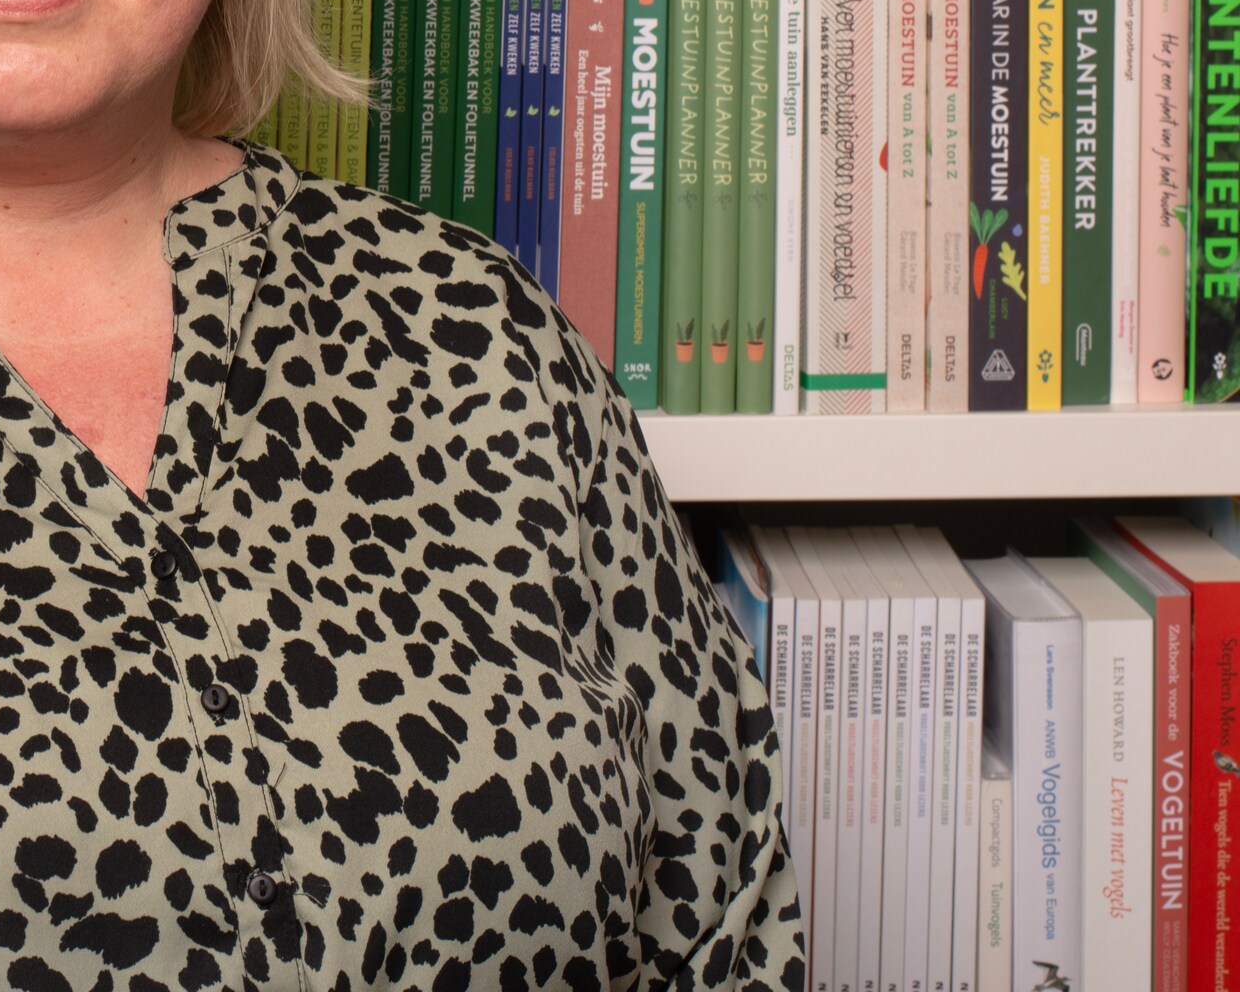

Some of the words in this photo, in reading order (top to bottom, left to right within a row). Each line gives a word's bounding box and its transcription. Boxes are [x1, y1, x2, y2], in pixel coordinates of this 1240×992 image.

[550, 13, 562, 33] ZELF
[787, 11, 801, 44] tuin
[991, 23, 1009, 46] IN
[1038, 22, 1057, 53] en
[483, 7, 495, 73] HANDBOEK
[549, 35, 561, 74] KWEKEN
[577, 50, 588, 70] Een
[991, 51, 1009, 80] DE
[466, 80, 479, 99] EN
[482, 78, 494, 114] VOOR
[577, 72, 588, 92] heel
[592, 66, 612, 108] Mijn
[783, 52, 801, 136] aanleggen
[1037, 60, 1060, 126] meer
[576, 95, 587, 116] jaar
[629, 18, 658, 190] MOESTUIN
[821, 83, 829, 135] EEKELEN
[902, 93, 912, 125] van
[1074, 9, 1098, 229] PLANTTREKKER
[574, 117, 586, 159] oogsten
[903, 129, 914, 140] A
[990, 86, 1010, 201] MOESTUIN
[462, 105, 478, 201] FOLIETUNNEL
[575, 162, 585, 177] uit
[590, 113, 609, 199] moestuin
[903, 143, 912, 165] tot
[575, 180, 585, 191] de
[903, 169, 914, 178] Z
[574, 194, 585, 214] tuin
[624, 363, 651, 371] SNOR
[968, 634, 978, 646] DE
[1167, 625, 1180, 685] Zakboek
[967, 649, 977, 717] SCHARRELAAR
[1113, 658, 1125, 686] LEN
[1168, 689, 1178, 720] voor
[1045, 721, 1055, 758] ANWB
[1113, 692, 1125, 761] HOWARD
[1168, 725, 1179, 740] de
[1110, 777, 1129, 826] Leven
[1219, 780, 1230, 805] Tien
[1038, 764, 1061, 868] Vogelgids
[1161, 751, 1183, 909] VOGELTUIN
[1214, 809, 1230, 848] vogels
[1110, 835, 1126, 864] met
[1217, 852, 1230, 869] die
[1046, 874, 1055, 894] van
[1103, 869, 1131, 919] vogels
[1217, 873, 1229, 890] de
[988, 882, 1003, 947] Tuinvogels
[1045, 899, 1057, 940] Europa
[1215, 891, 1230, 930] wereld
